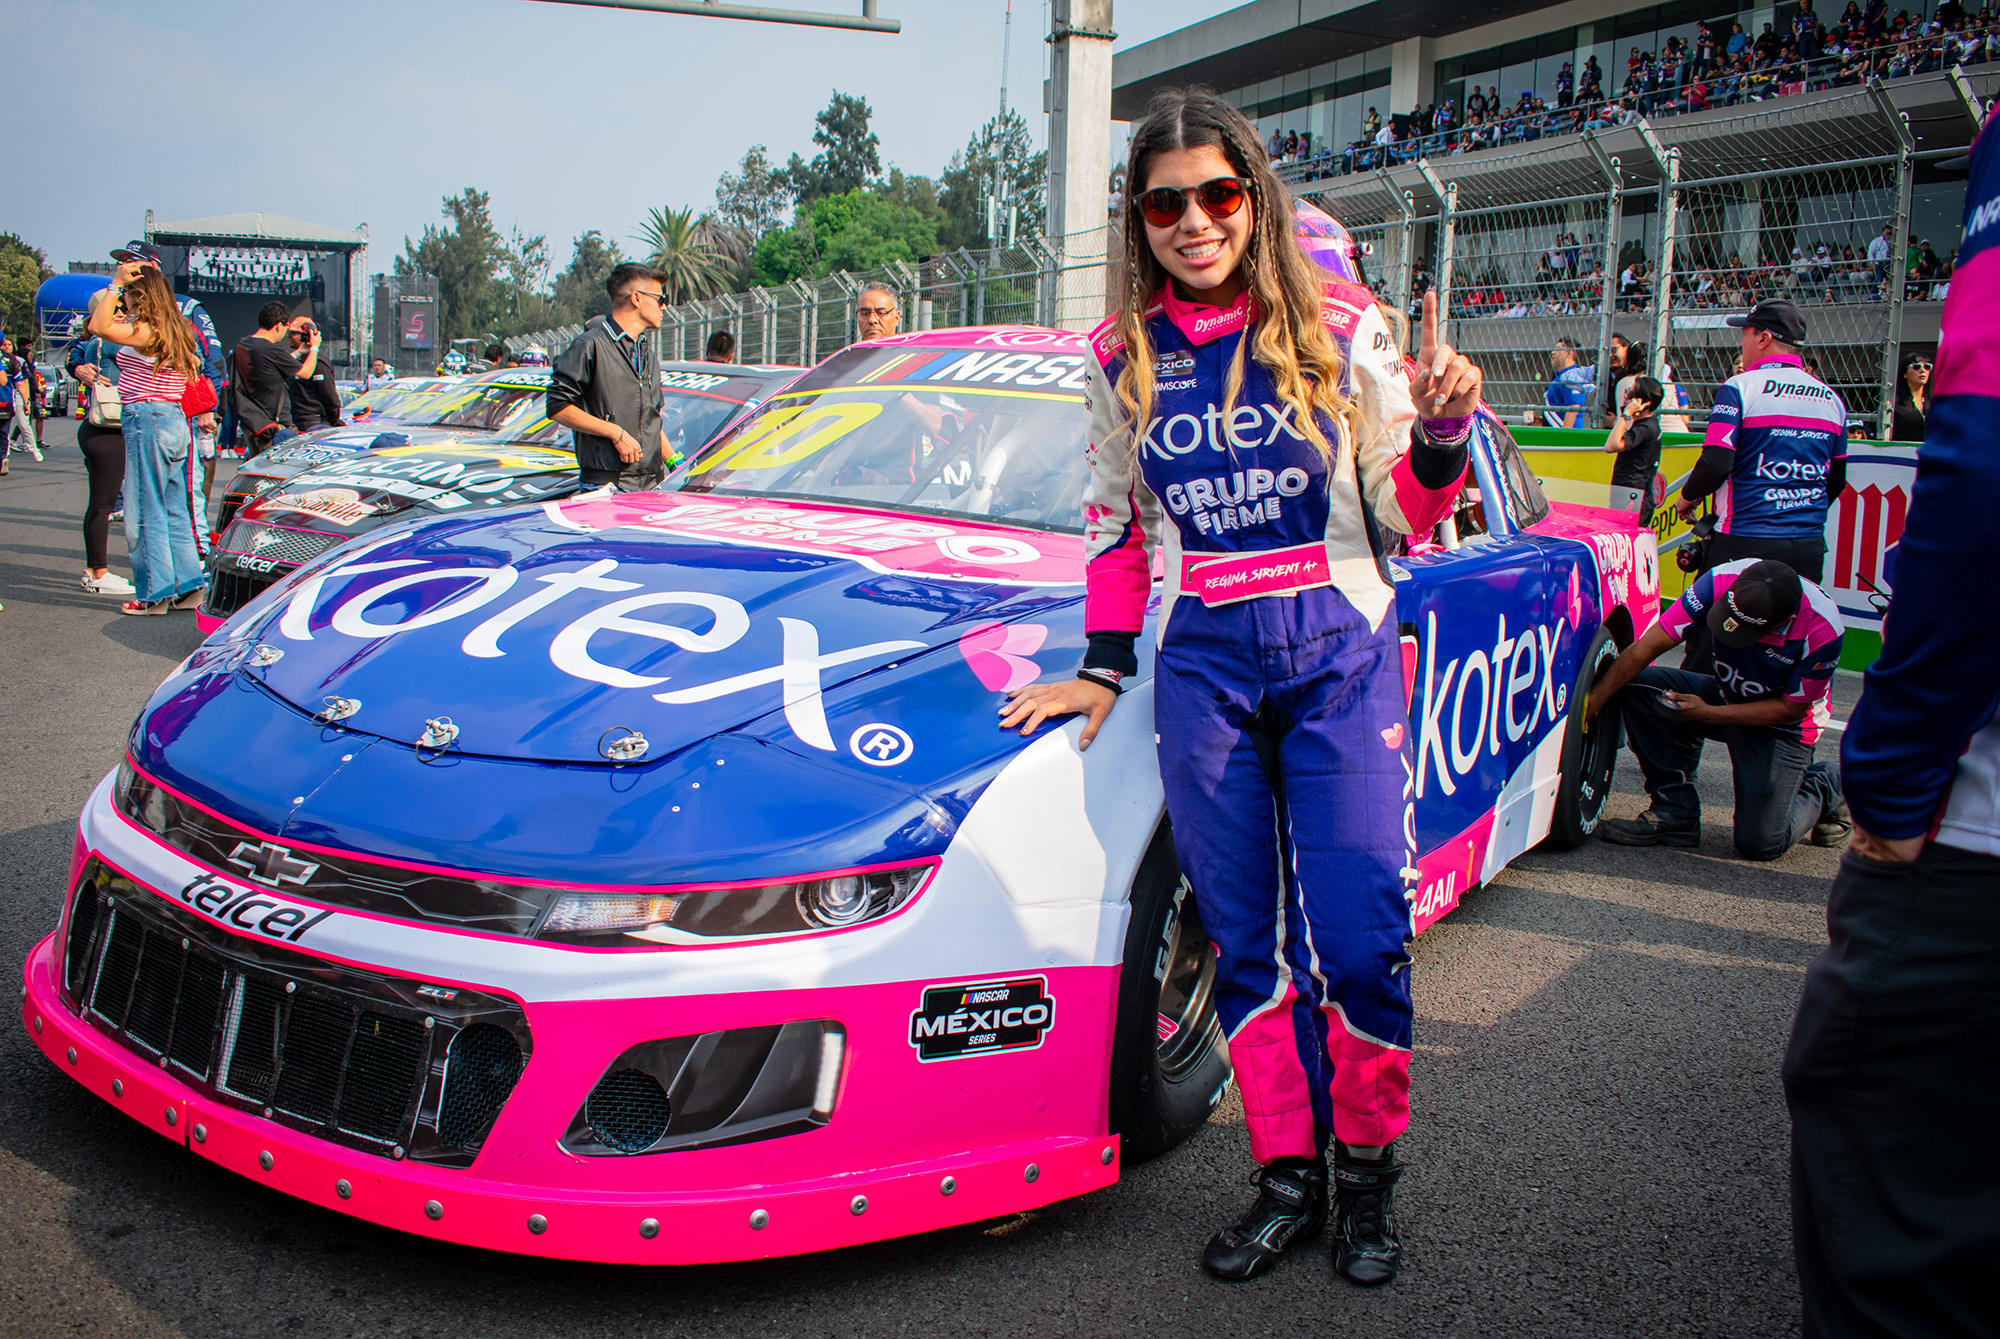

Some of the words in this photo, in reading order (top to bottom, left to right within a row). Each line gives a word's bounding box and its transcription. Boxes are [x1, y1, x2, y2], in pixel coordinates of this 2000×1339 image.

[1194, 306, 1243, 332] Dynamic
[1320, 311, 1350, 326] OMP
[974, 331, 1088, 348] kot
[1762, 380, 1834, 401] Dynamic
[1165, 467, 1309, 515] GRUPO
[1192, 496, 1281, 536] FIRME
[235, 554, 280, 573] telcel
[1205, 571, 1248, 590] REGINA
[1247, 560, 1301, 582] SIRVENT
[1728, 591, 1768, 626] Dynamic
[1416, 610, 1565, 799] kotex
[181, 872, 336, 942] telcel
[972, 989, 1010, 1004] NASCAR
[915, 1004, 1049, 1038] MÉXICO
[968, 1033, 997, 1045] SERIES
